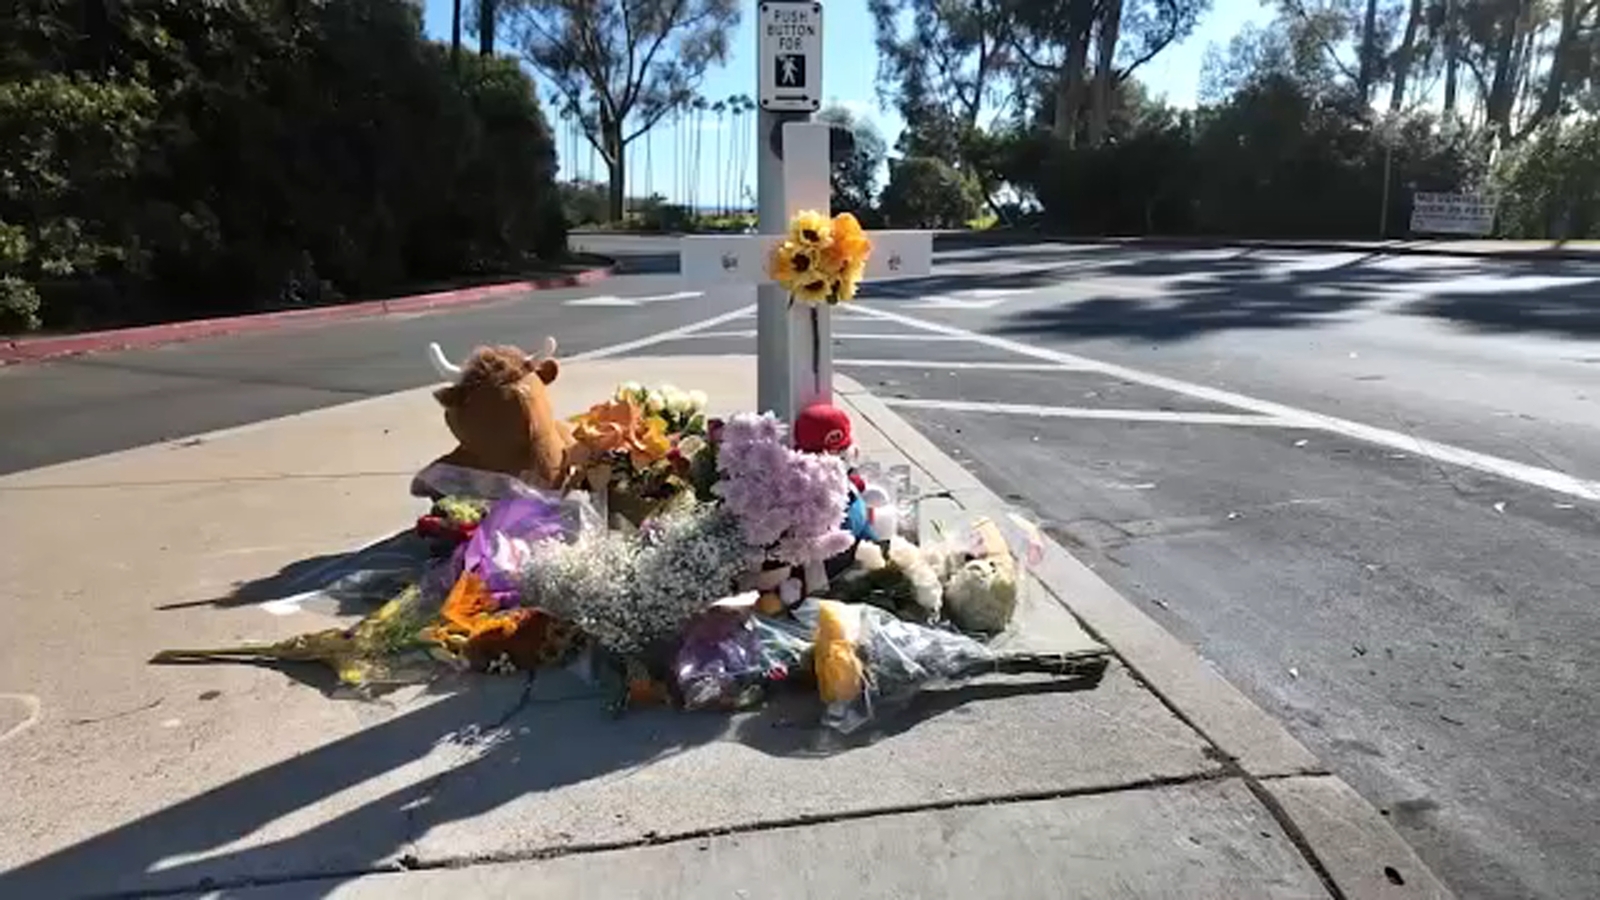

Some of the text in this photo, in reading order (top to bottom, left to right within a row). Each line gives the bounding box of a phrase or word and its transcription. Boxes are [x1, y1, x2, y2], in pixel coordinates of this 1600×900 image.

[774, 10, 807, 22] PUSH
[767, 25, 814, 36] BUTTON
[779, 37, 802, 50] FOR
